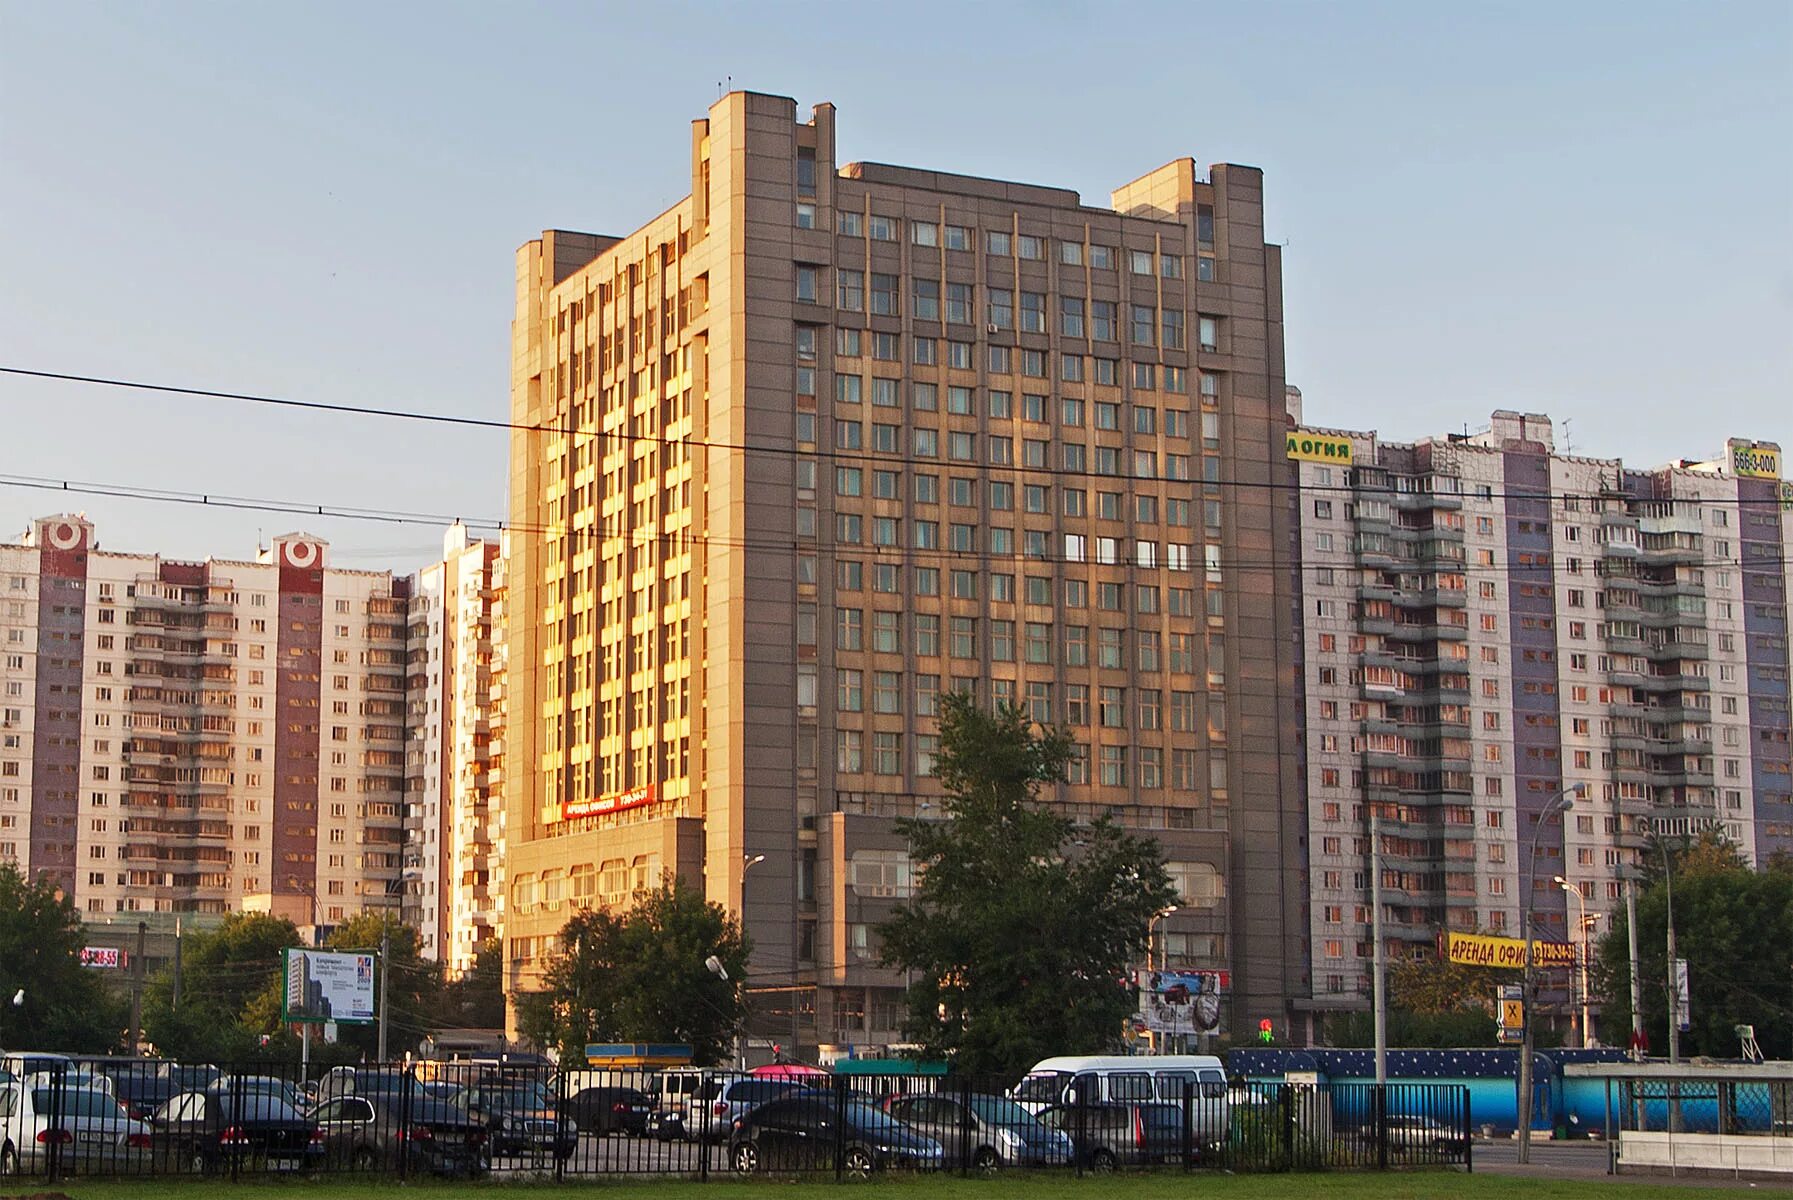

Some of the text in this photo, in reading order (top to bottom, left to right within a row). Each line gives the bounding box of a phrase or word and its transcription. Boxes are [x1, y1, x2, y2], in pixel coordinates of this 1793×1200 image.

[1287, 438, 1349, 458] ЛОГИЯ
[1734, 451, 1775, 473] 666-3-000
[1451, 940, 1495, 962] АРЕНДА
[1499, 944, 1541, 965] ОФИСВ
